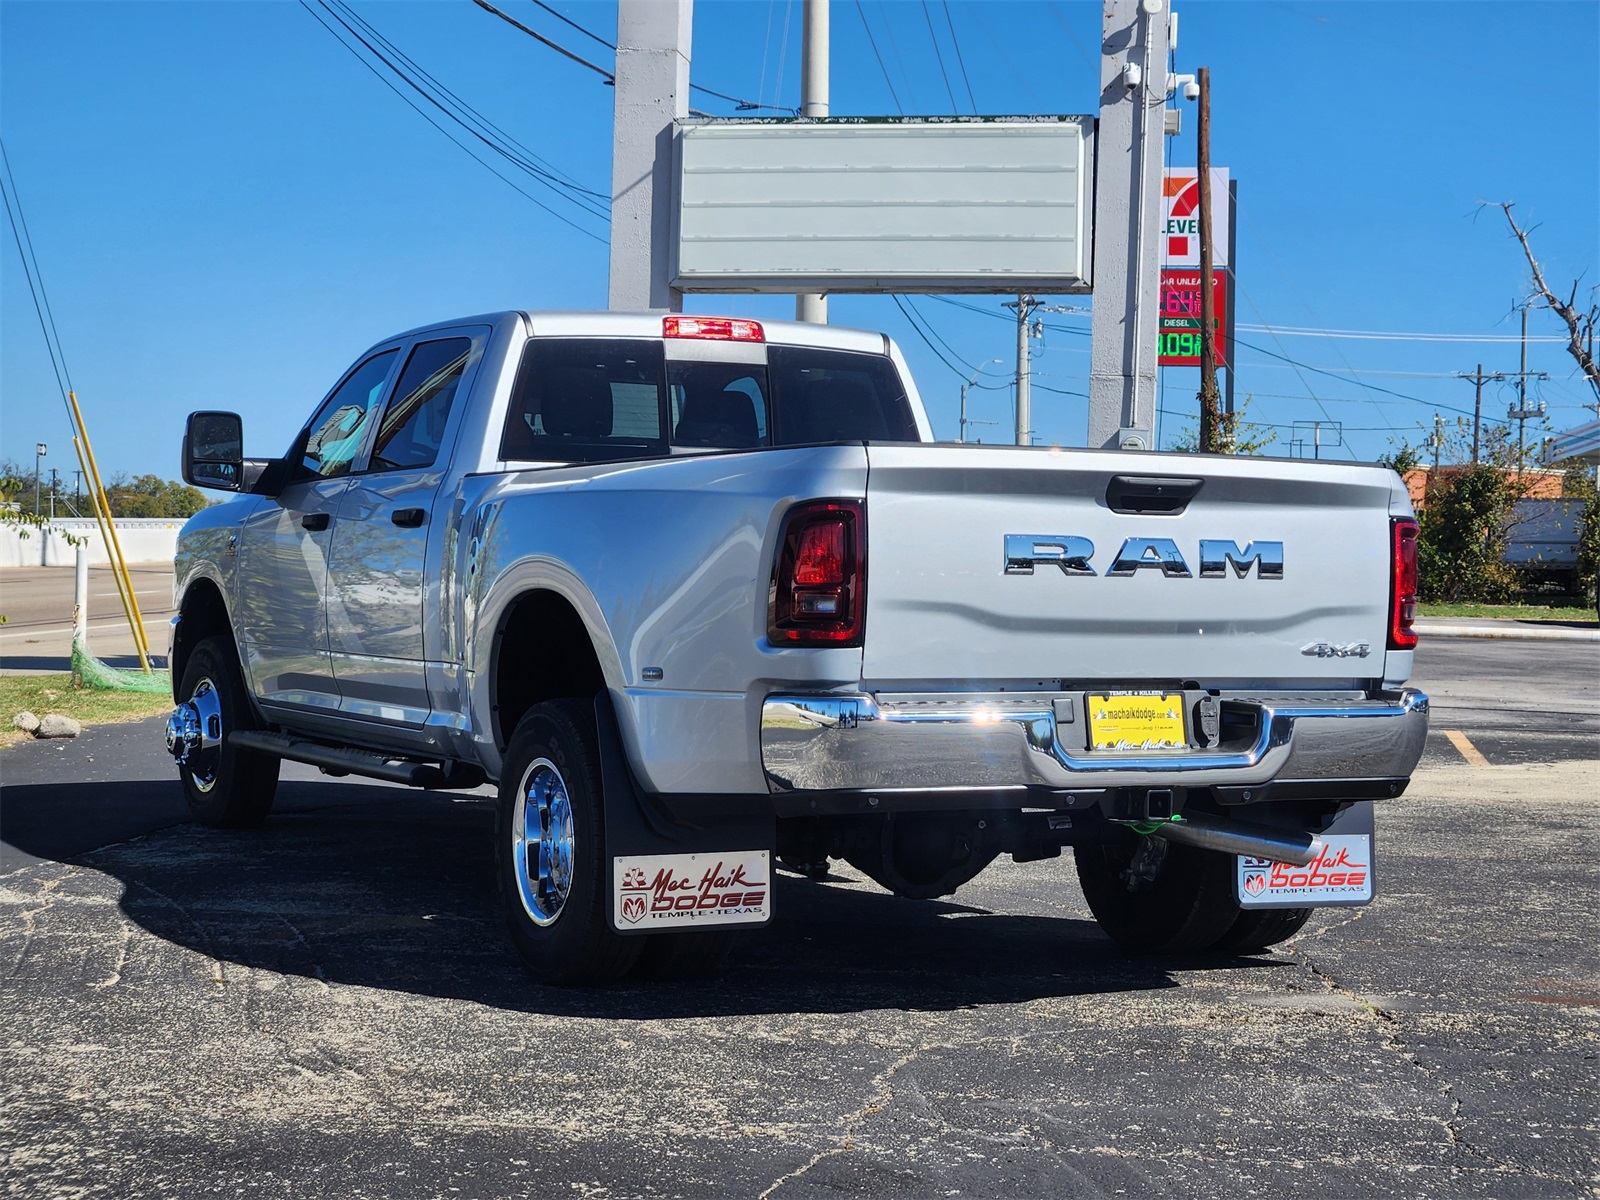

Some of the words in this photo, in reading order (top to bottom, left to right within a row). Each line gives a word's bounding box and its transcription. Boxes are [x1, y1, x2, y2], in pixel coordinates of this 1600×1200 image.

[1161, 219, 1201, 234] EVE
[1164, 319, 1190, 327] DIESEL
[1003, 533, 1284, 580] RAM
[1300, 640, 1372, 659] 4x4
[1107, 707, 1166, 721] machaikdodge.com
[650, 867, 697, 904] Mac
[698, 860, 767, 899] Haik
[1269, 872, 1366, 887] DODGE
[650, 891, 766, 912] DODGE
[650, 910, 708, 919] TEMPLE
[715, 906, 763, 915] TEXAS
